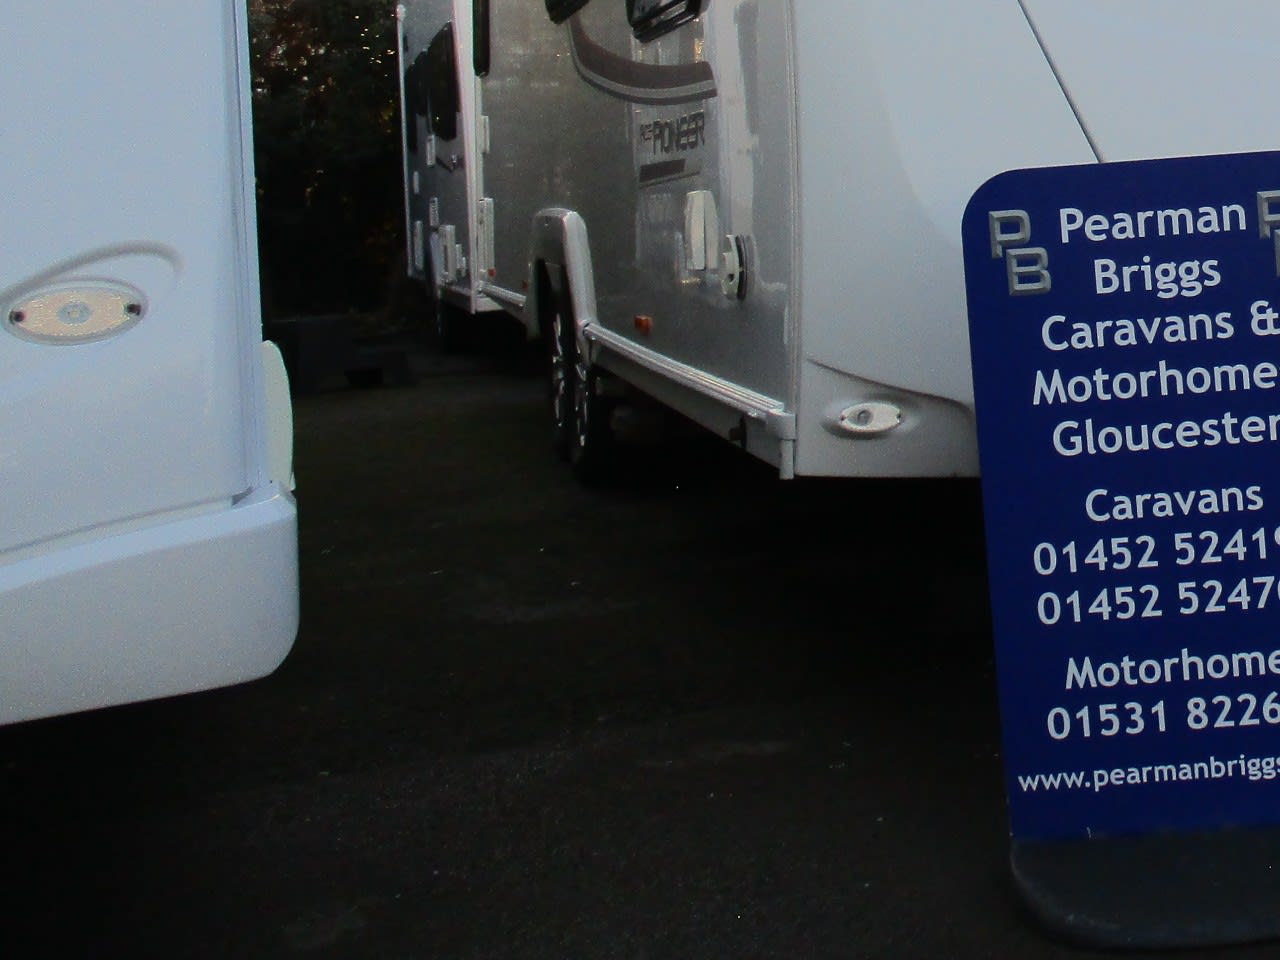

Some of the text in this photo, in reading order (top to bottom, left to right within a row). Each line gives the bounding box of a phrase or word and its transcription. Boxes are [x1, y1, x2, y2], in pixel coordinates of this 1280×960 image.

[1059, 203, 1247, 244] Pearman
[1093, 255, 1222, 299] Briggs
[1041, 300, 1280, 351] Caravans &
[1085, 484, 1264, 522] Caravans
[1033, 534, 1159, 576] 01452
[1037, 584, 1163, 625] 01452
[1047, 700, 1167, 741] 01531
